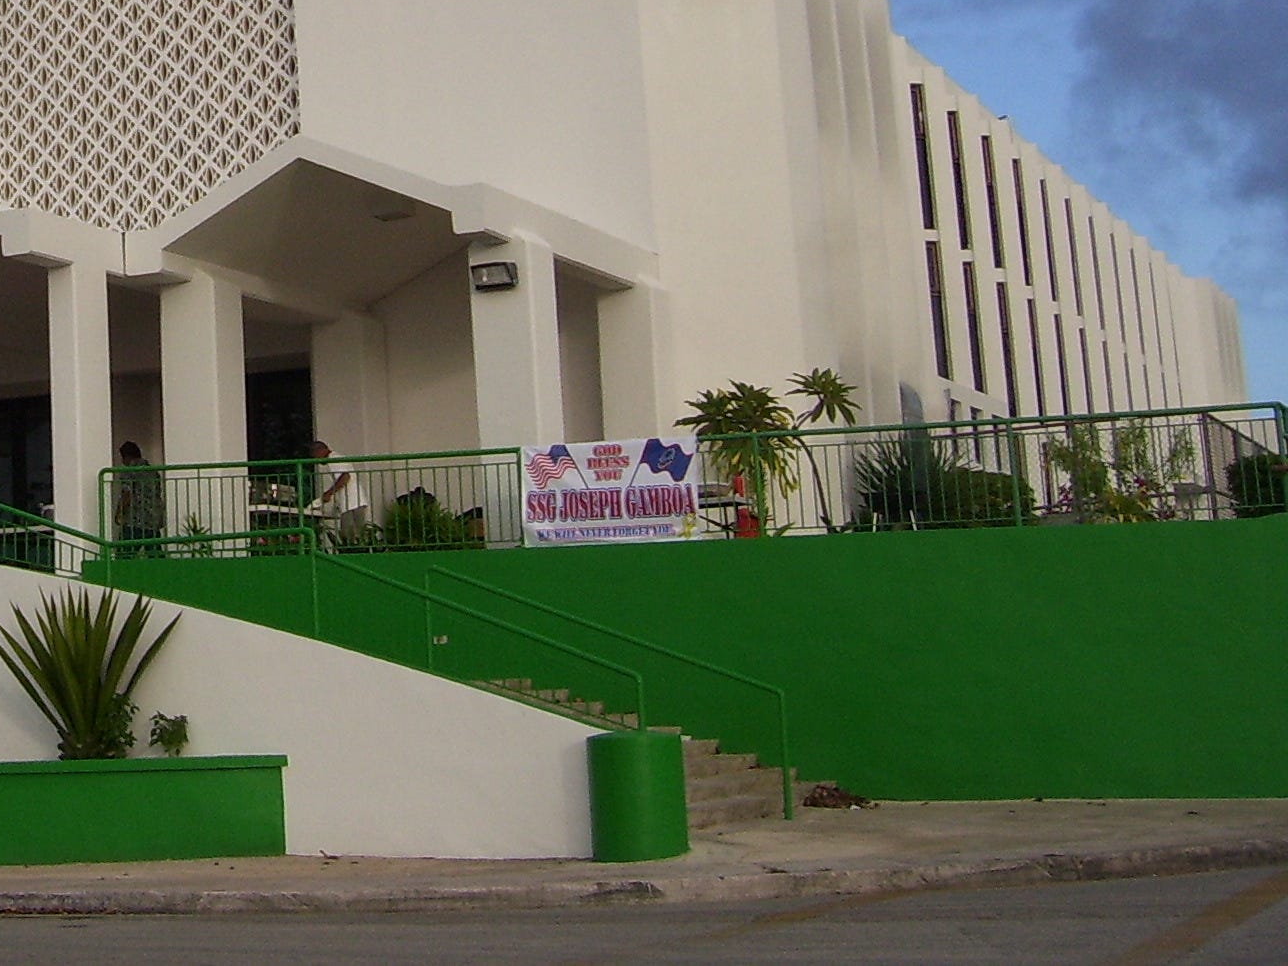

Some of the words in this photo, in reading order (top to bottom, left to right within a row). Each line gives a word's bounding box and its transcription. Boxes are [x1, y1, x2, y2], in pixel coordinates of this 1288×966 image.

[587, 456, 630, 469] BLESS
[594, 469, 622, 481] YOU
[526, 490, 556, 523] SSG
[559, 486, 622, 522] JOSEPH
[625, 483, 696, 519] GAMBOA
[579, 527, 611, 538] NEVER
[613, 525, 649, 537] FORGET
